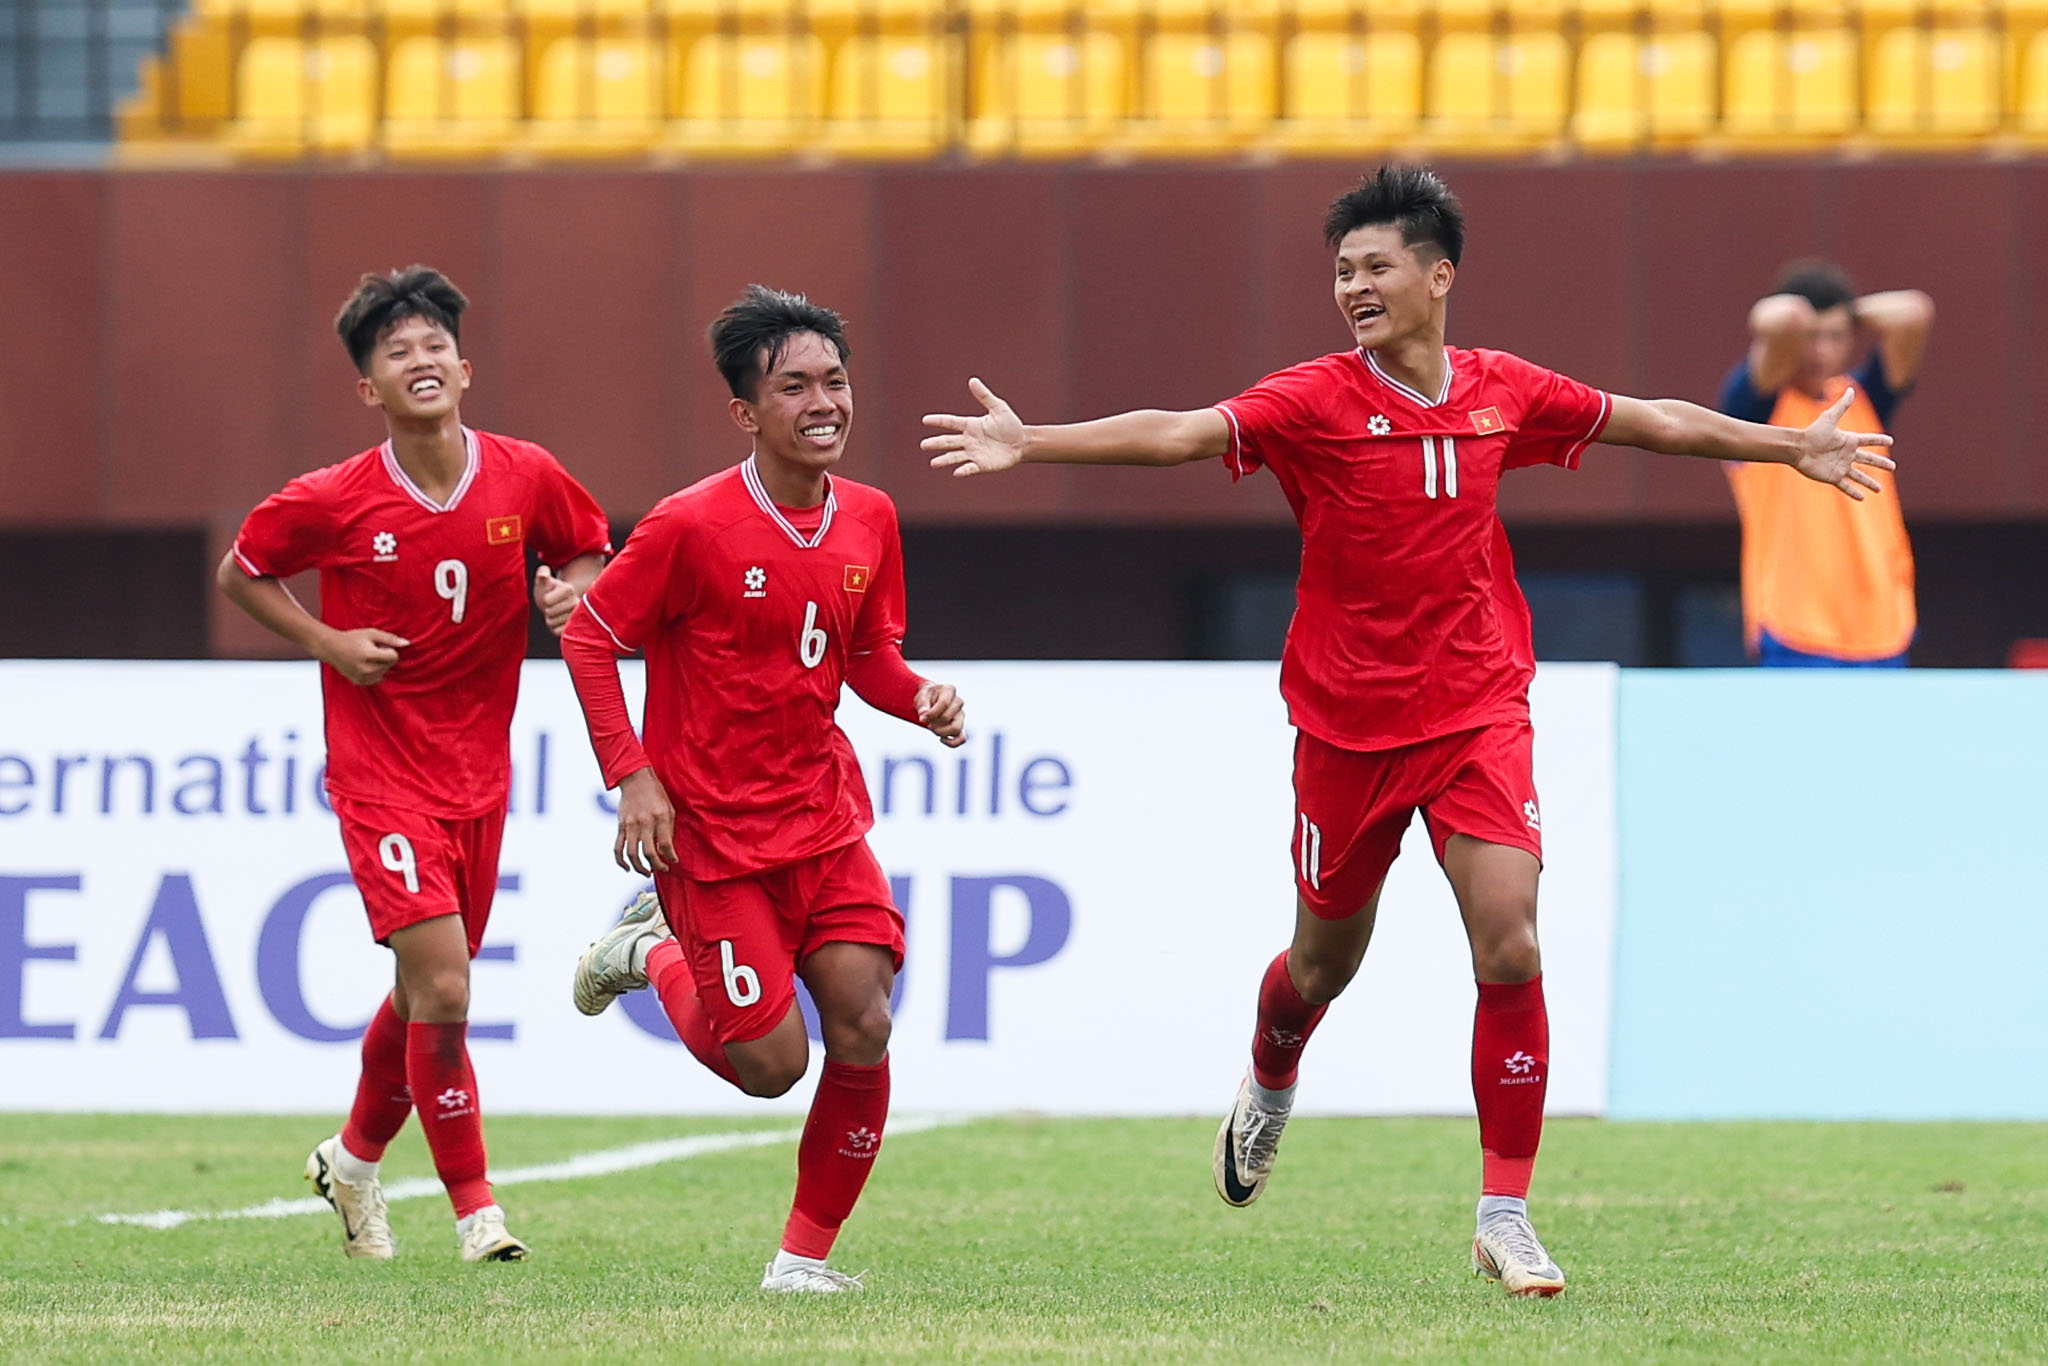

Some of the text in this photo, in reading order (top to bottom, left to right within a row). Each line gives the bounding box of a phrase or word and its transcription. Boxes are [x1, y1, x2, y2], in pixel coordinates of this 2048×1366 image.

[1421, 435, 1457, 498] 11
[434, 558, 468, 624] 9
[800, 600, 828, 669] 6
[0, 731, 547, 815] ernatil
[378, 832, 420, 893] 9
[1300, 811, 1321, 891] 11
[720, 939, 761, 1008] 6
